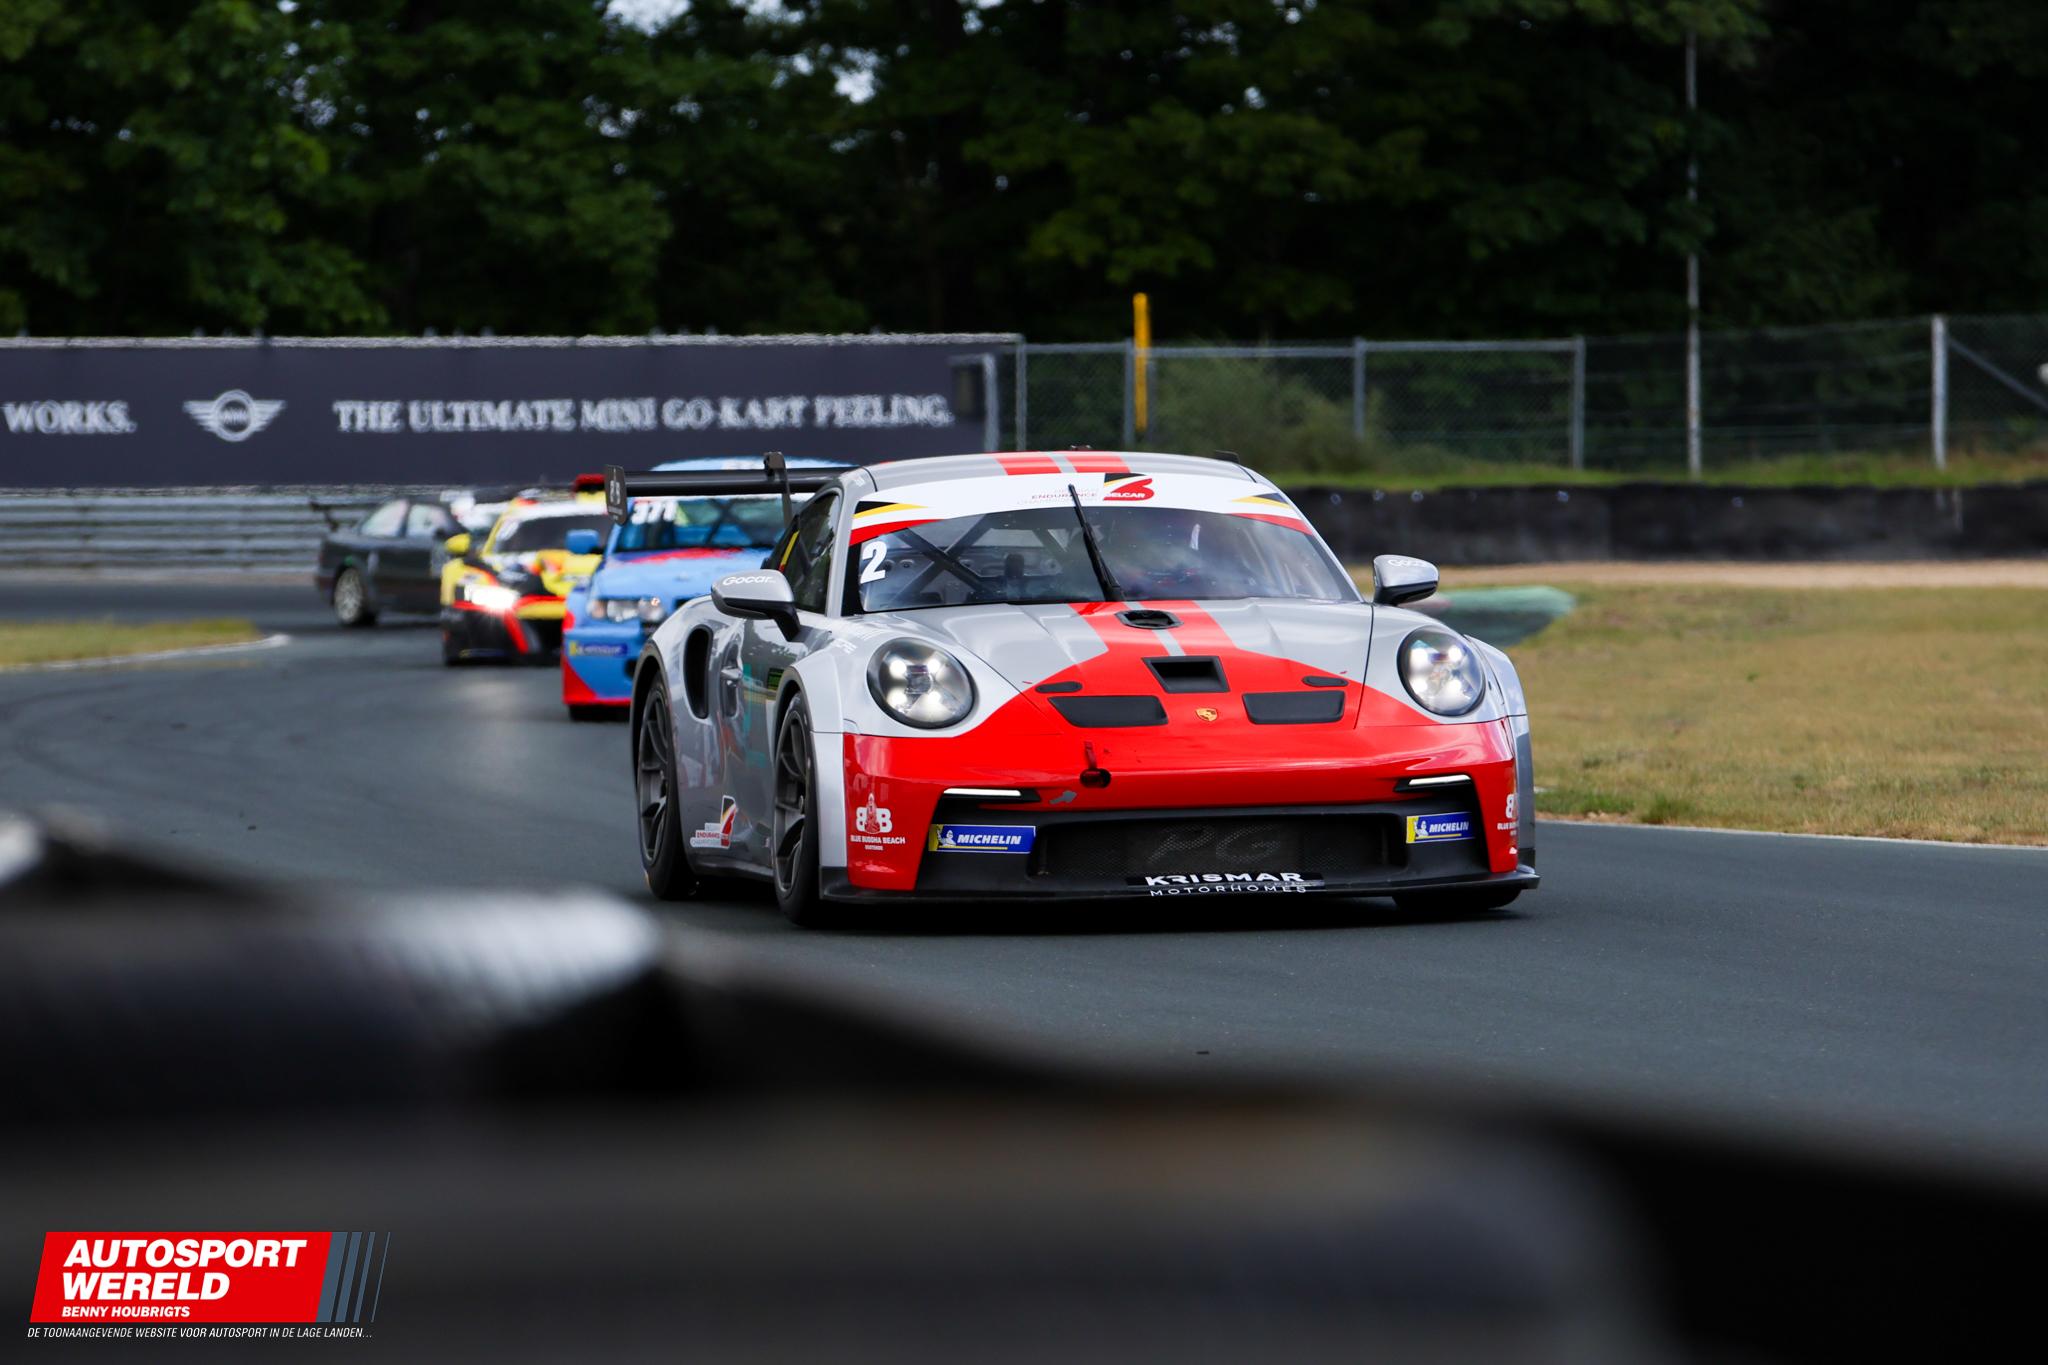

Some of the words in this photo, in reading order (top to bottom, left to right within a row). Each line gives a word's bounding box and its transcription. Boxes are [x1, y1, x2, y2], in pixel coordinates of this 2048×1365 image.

[3, 401, 137, 434] WORKS.
[333, 400, 402, 432] THE
[408, 399, 576, 432] ULTIMATE
[581, 398, 657, 431] MINI
[860, 541, 888, 584] 2
[1429, 821, 1470, 833] MICHELIN
[957, 834, 1022, 845] MICHELIN
[1145, 872, 1305, 886] KRISMAR
[1150, 885, 1307, 897] MOTORHOMES
